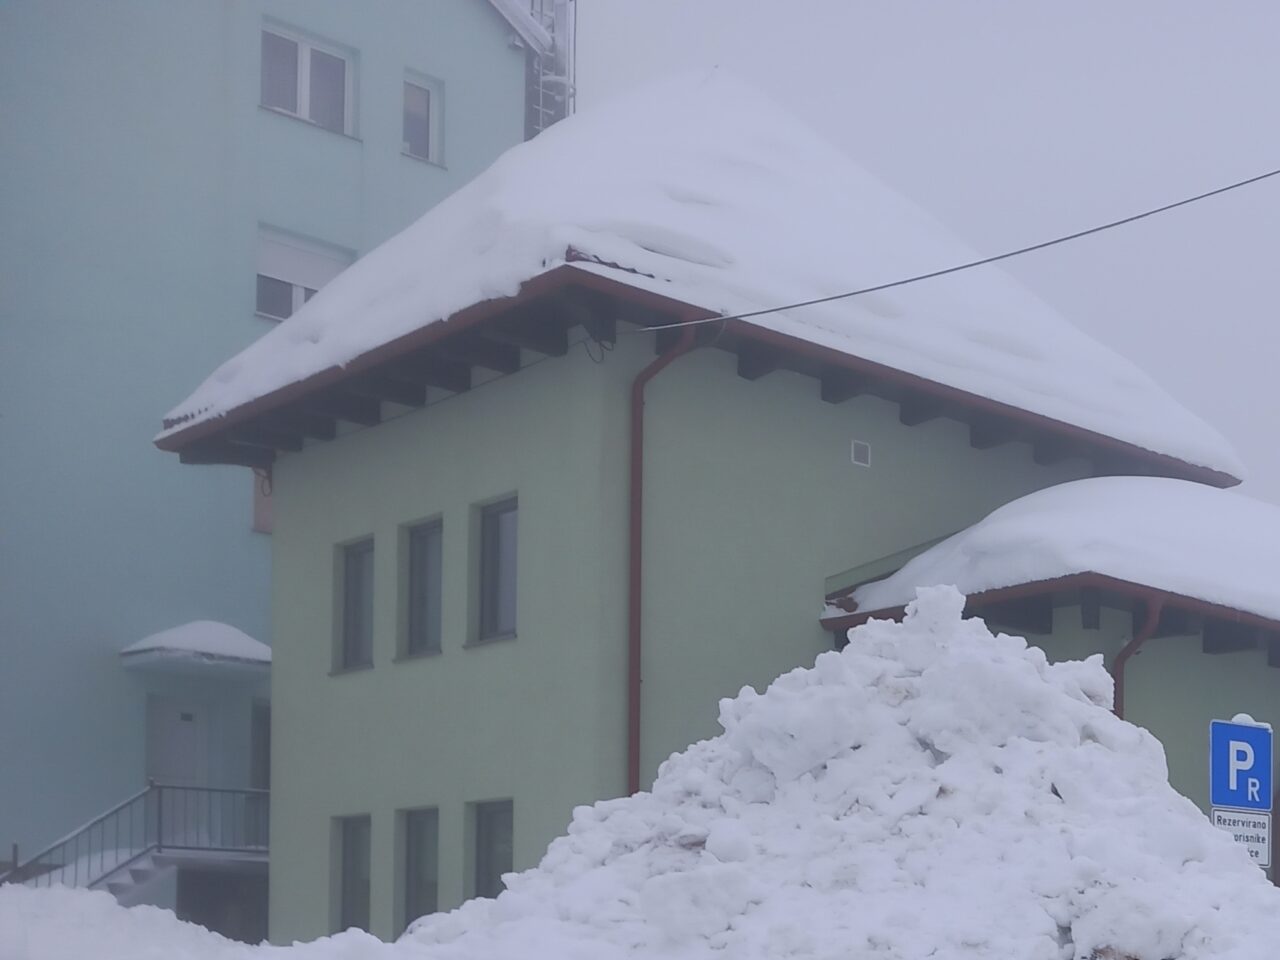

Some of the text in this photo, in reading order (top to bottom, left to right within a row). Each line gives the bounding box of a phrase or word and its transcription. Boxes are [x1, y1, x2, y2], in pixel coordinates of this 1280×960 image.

[1229, 740, 1254, 790] P
[1248, 778, 1260, 801] R
[1217, 815, 1266, 829] Rezervirano
[1234, 833, 1266, 844] orisnike
